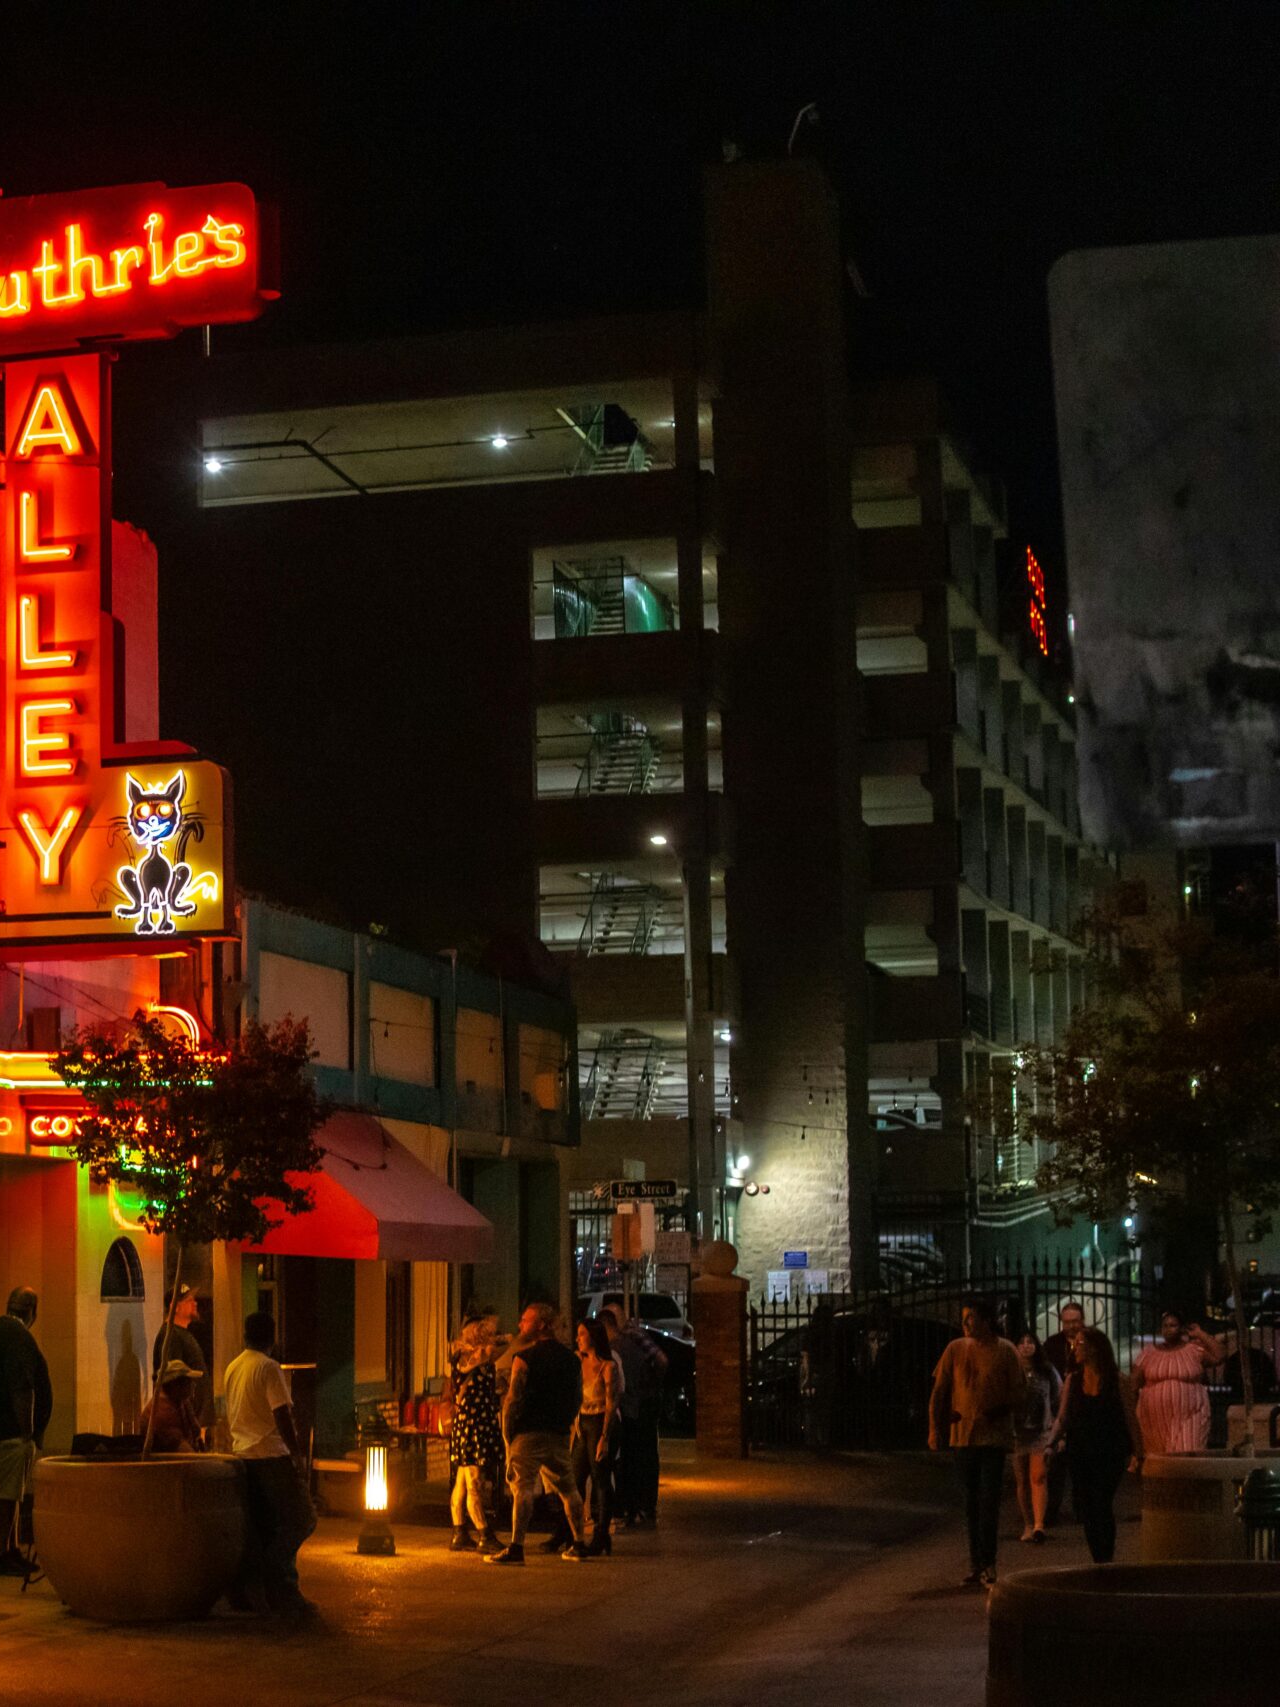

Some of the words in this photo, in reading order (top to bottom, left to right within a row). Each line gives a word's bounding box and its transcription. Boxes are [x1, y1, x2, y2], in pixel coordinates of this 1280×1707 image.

[18, 386, 82, 885] ALLEY
[617, 1184, 636, 1197] Eye
[641, 1183, 670, 1195] Street
